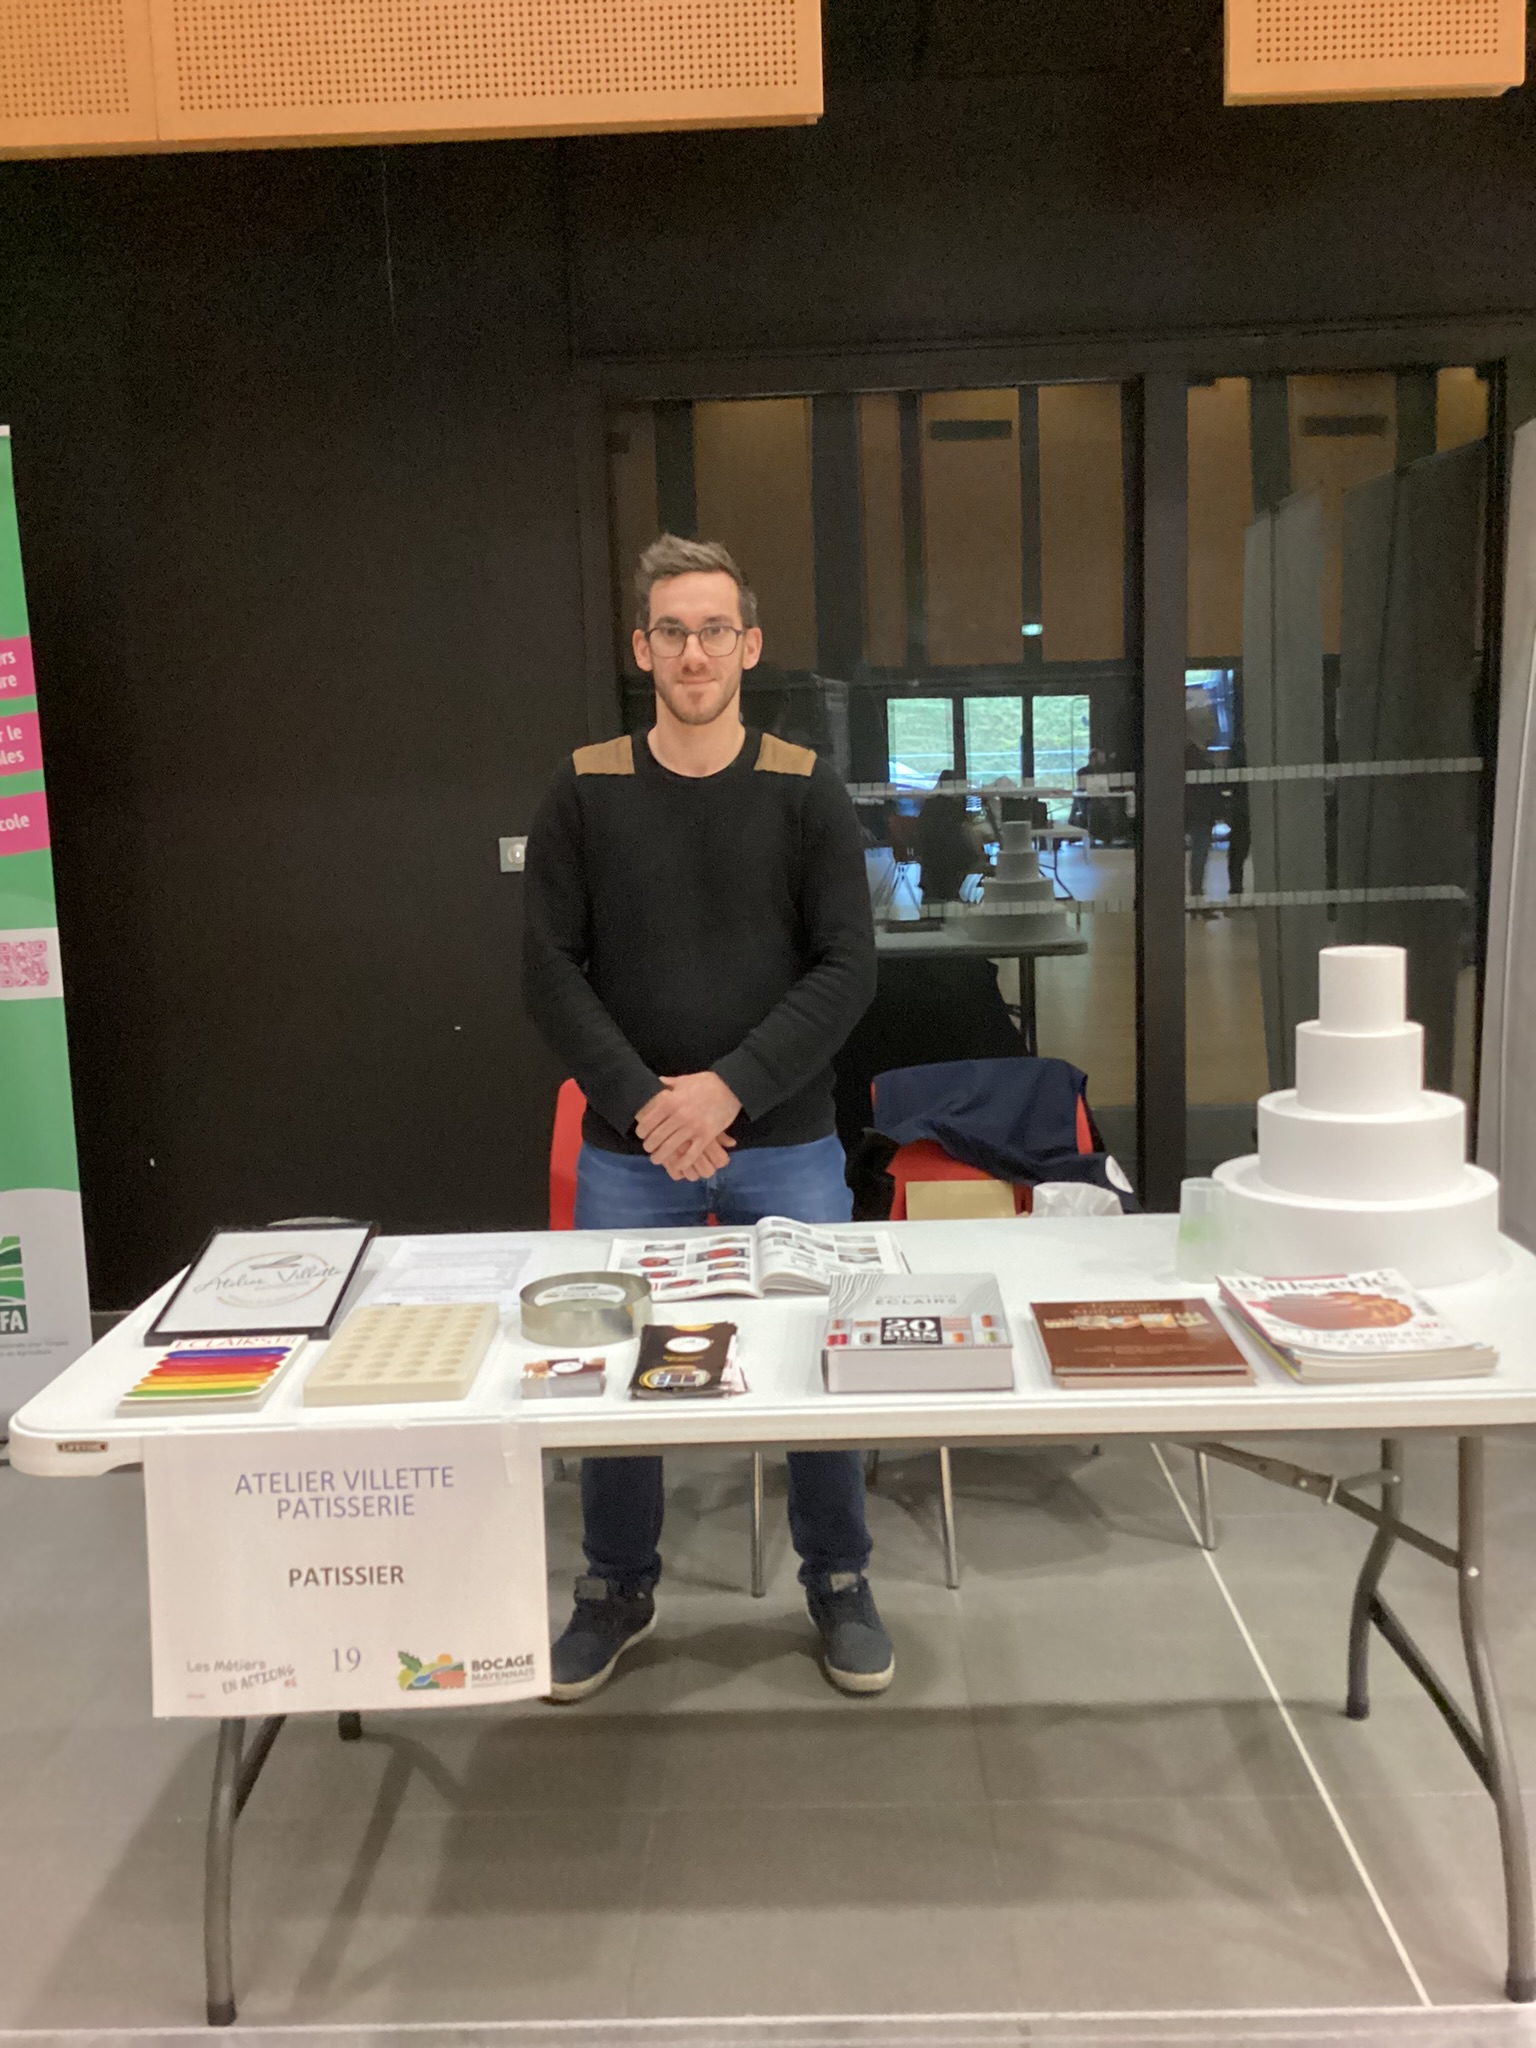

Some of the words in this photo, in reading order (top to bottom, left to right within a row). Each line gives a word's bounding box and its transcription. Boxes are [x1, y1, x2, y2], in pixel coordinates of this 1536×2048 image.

[6, 725, 23, 741] le
[234, 1470, 336, 1496] ATELIER
[343, 1465, 455, 1492] VILLETTE
[276, 1494, 415, 1520] PATISSERIE
[288, 1564, 405, 1588] PATISSIER
[186, 1659, 211, 1673] Les
[332, 1646, 361, 1673] 19
[471, 1654, 535, 1672] BOCAGE
